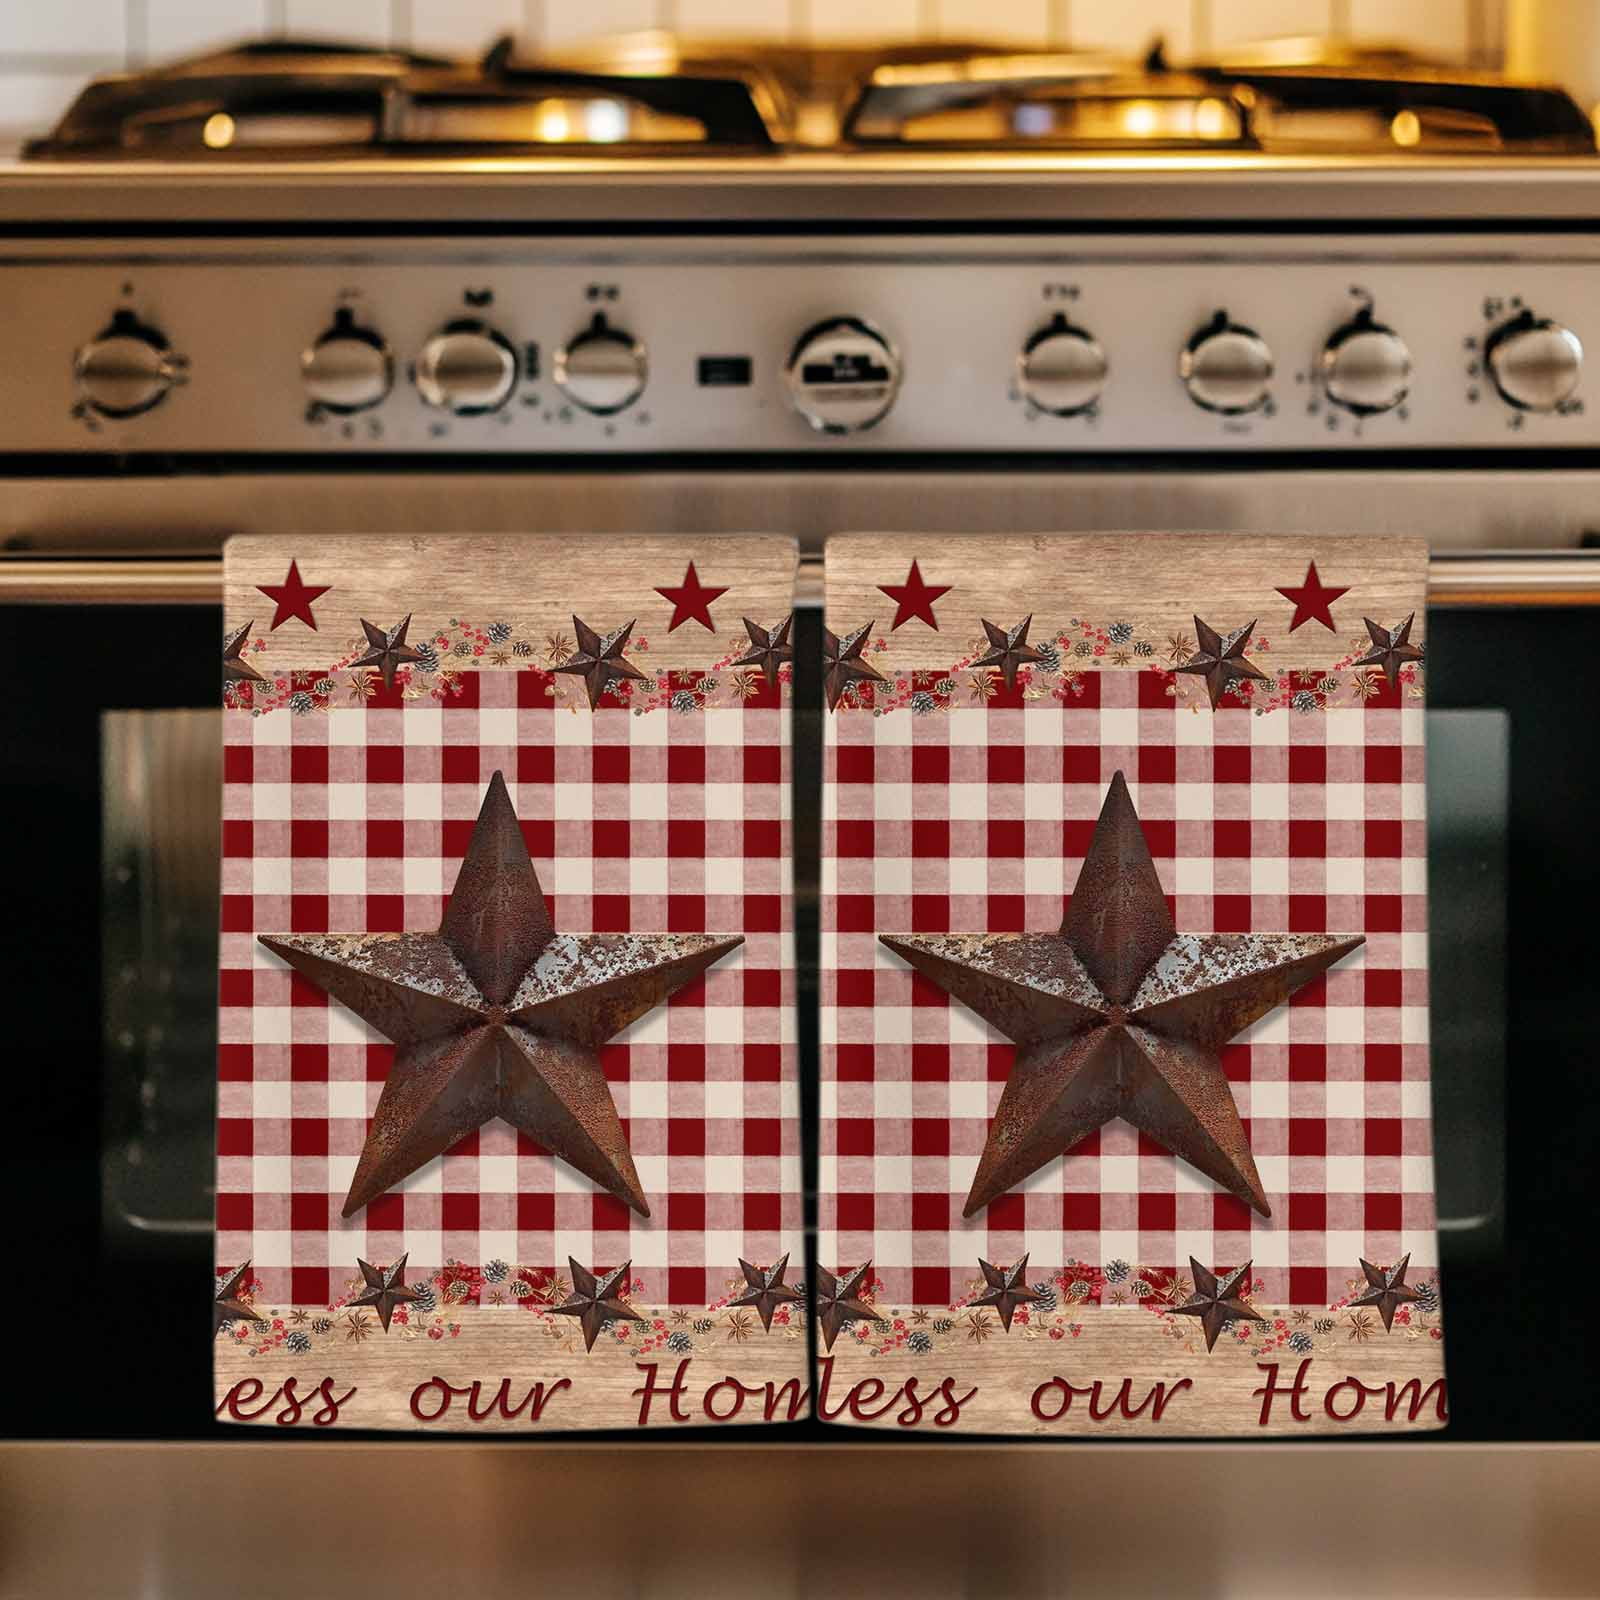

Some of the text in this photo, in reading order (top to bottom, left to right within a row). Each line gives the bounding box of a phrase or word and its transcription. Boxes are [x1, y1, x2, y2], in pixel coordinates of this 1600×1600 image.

[216, 1376, 358, 1426] ess
[409, 1376, 572, 1423] our
[817, 1355, 1448, 1428] less our Hom
